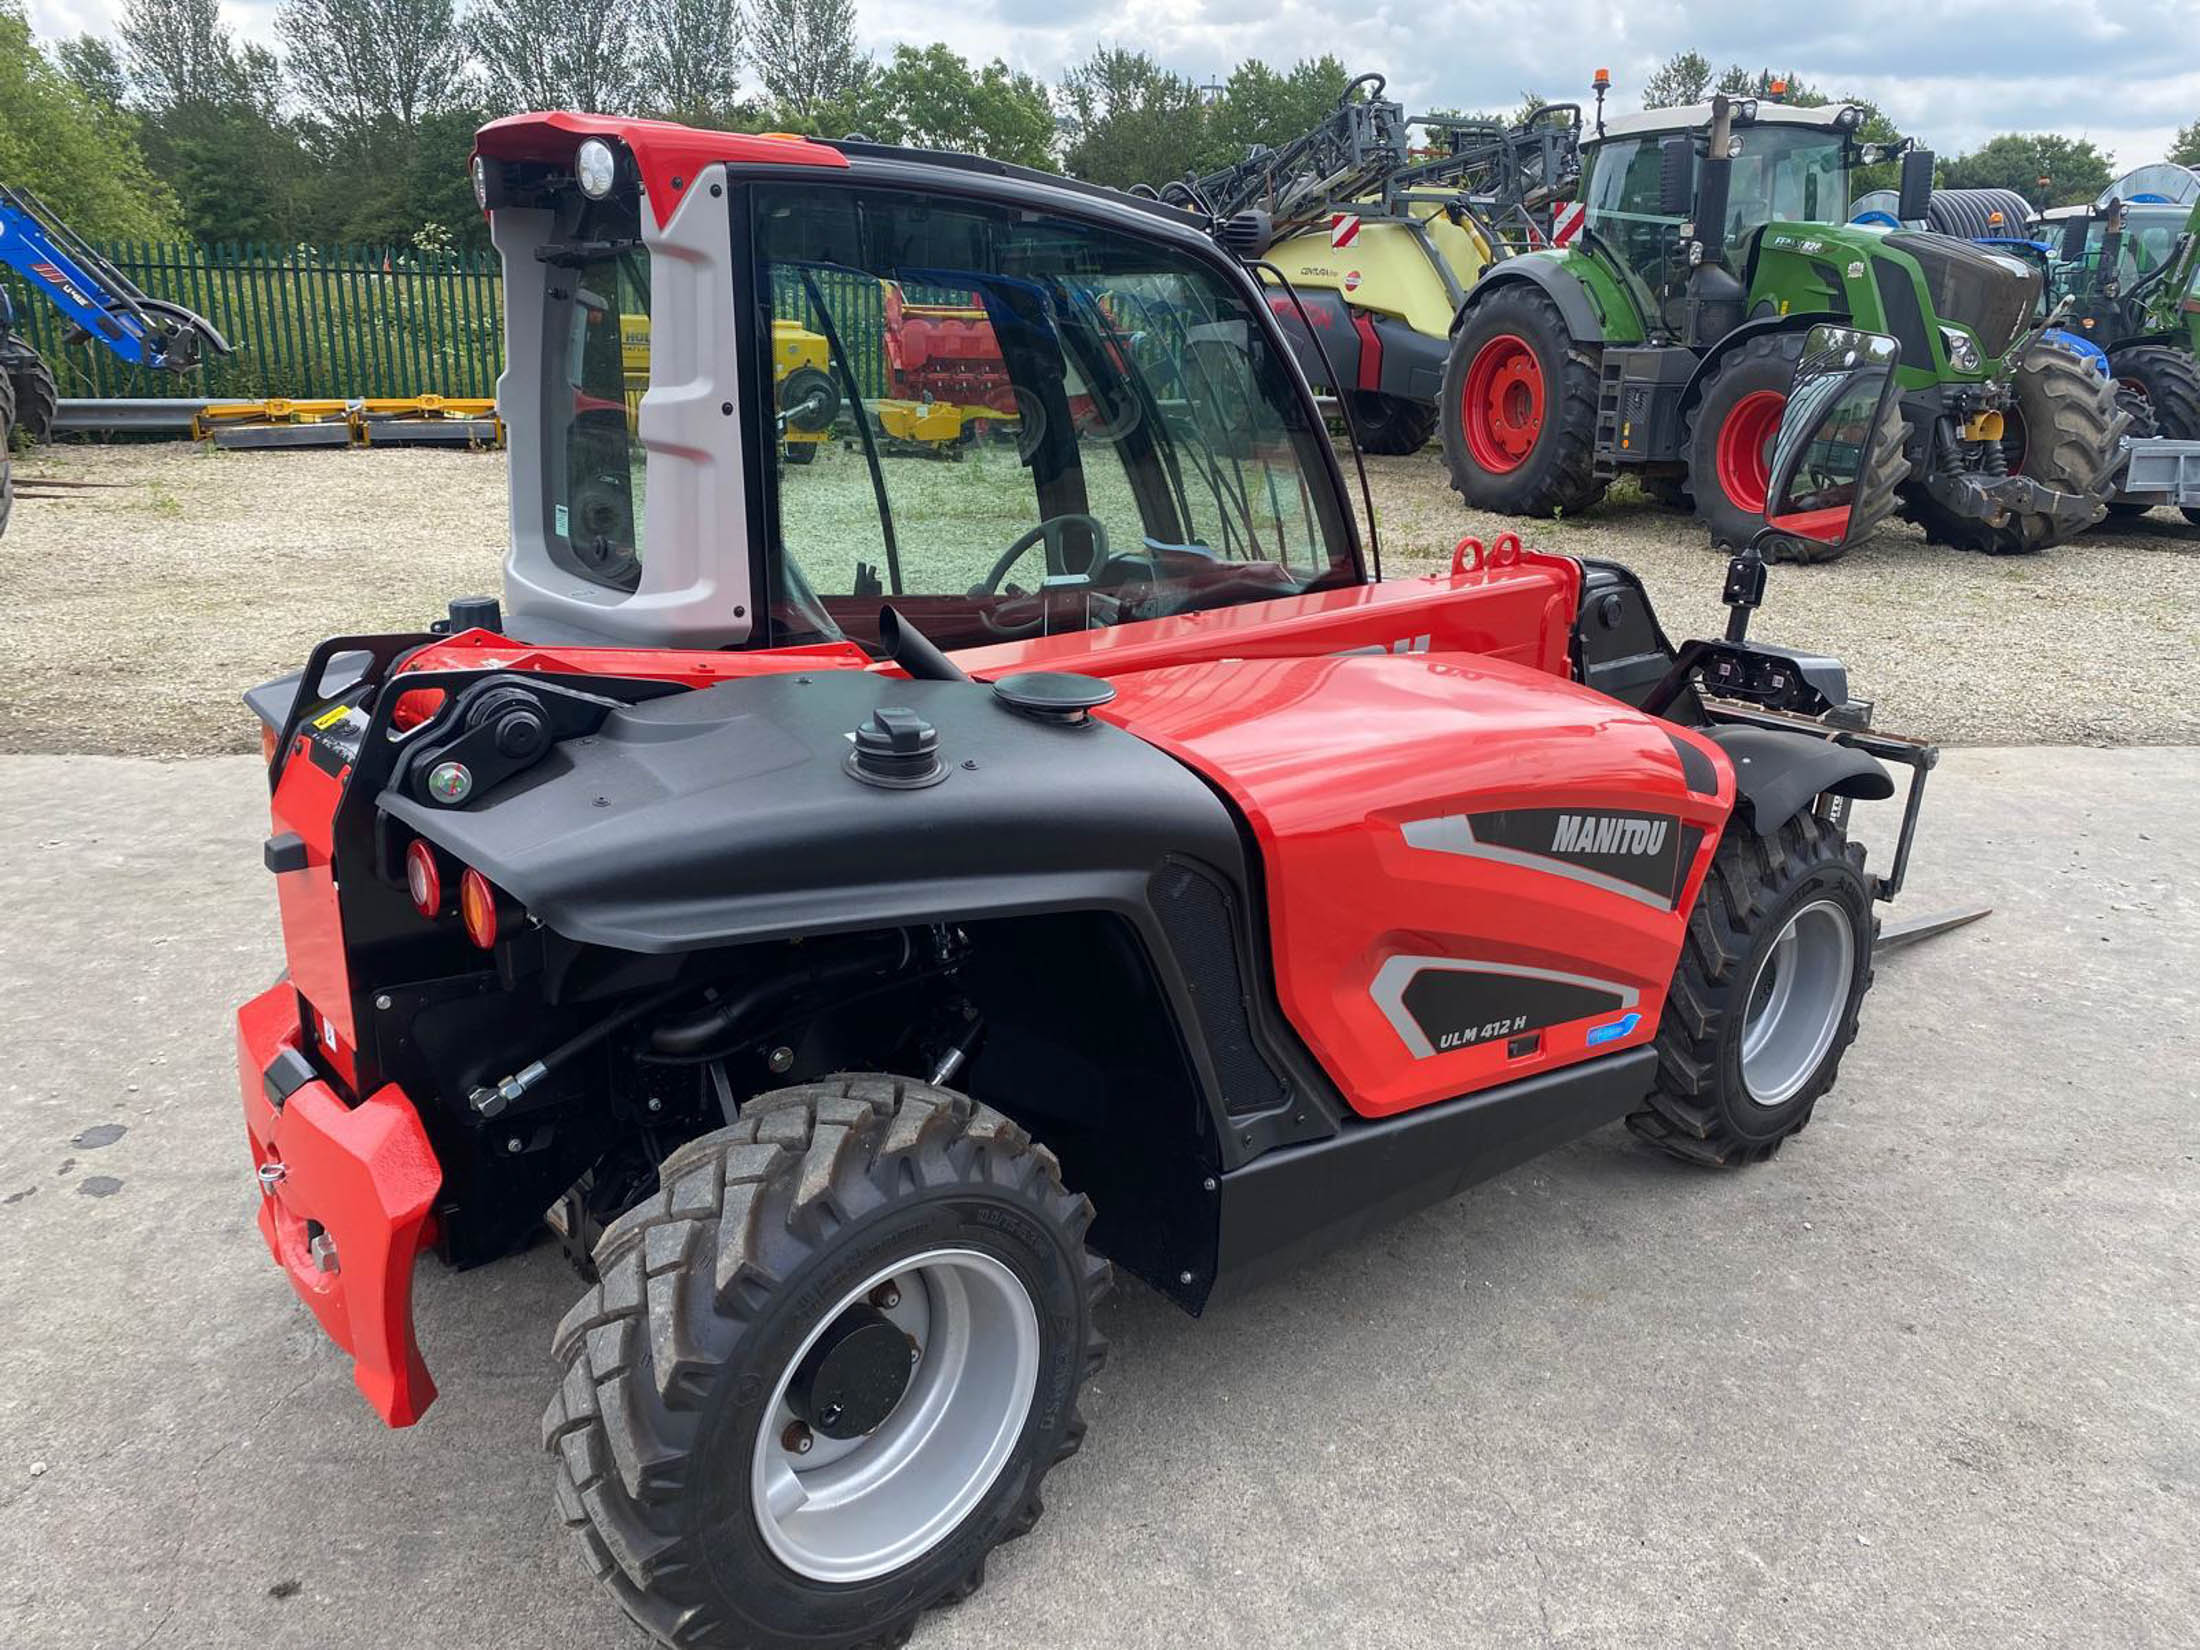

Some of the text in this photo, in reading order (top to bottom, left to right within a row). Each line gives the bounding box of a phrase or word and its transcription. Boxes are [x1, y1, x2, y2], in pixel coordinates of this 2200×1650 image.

[1551, 814, 1668, 856] MANITOU
[1440, 1015, 1527, 1049] ULM 412 H
